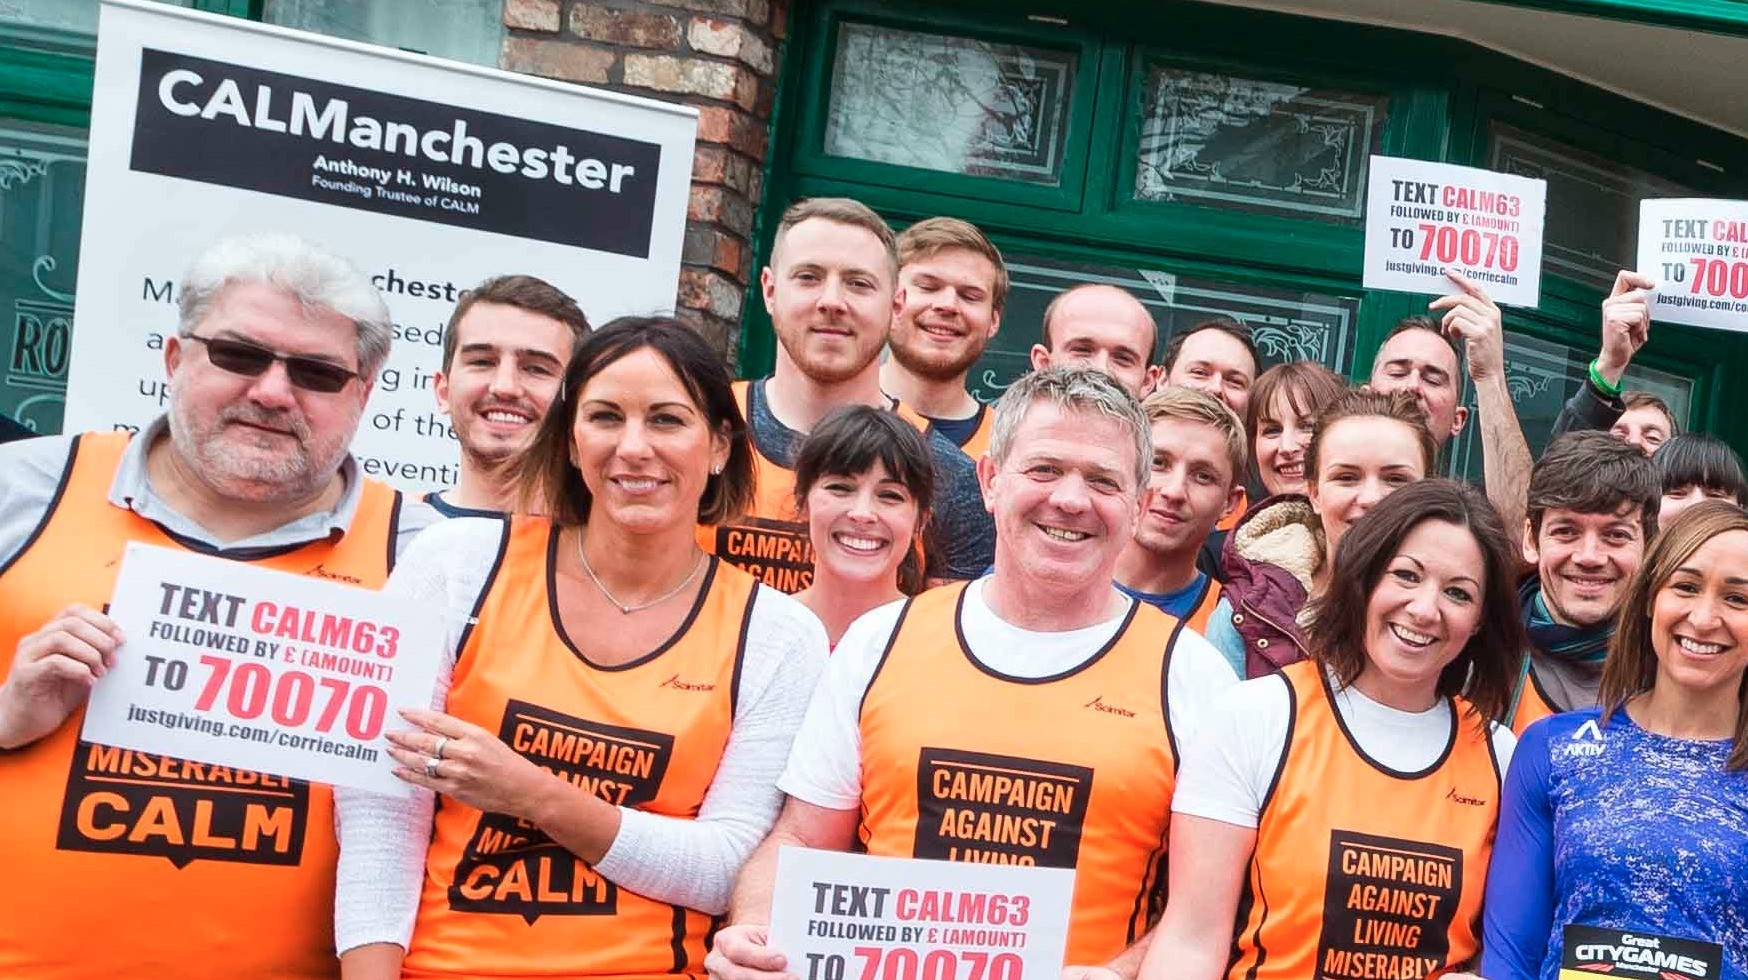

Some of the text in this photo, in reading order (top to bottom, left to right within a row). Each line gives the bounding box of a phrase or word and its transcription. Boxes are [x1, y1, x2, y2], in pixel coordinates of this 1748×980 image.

[158, 69, 635, 194] CALManchester
[312, 175, 480, 214] Founding Trustee of CALM
[313, 155, 482, 198] Anthony H. Wilson
[1390, 204, 1461, 224] FOLLOWED BY
[1391, 179, 1520, 217] TEXT CALM63
[1389, 223, 1519, 273] TO 70070
[1661, 241, 1715, 256] FOLLOWED
[1716, 244, 1731, 257] BY
[1662, 218, 1709, 240] TEXT
[1661, 262, 1686, 284] TO
[373, 411, 404, 431] of
[149, 620, 250, 655] FOLLOWED
[253, 640, 280, 660] BY
[159, 582, 400, 659] TEXT CALM63
[144, 654, 388, 742] TO 70070
[126, 703, 379, 763] justgiving.com/corriecalm
[513, 722, 655, 779] CAMPAIGN
[933, 768, 1074, 814] CAMPAIGN
[76, 792, 294, 853] CALM
[939, 808, 1056, 849] AGAINST
[459, 856, 607, 903] CALM
[1341, 848, 1454, 890] CAMPAIGN
[812, 881, 1031, 927] TEXT CALM63
[1346, 885, 1441, 921] AGAINST
[807, 919, 897, 942] FOLLOWED
[900, 926, 924, 944] BY
[1354, 921, 1422, 949] LIVING
[1621, 934, 1661, 949] Great
[1324, 947, 1439, 980] MISERABLY
[1575, 944, 1708, 978] CITYGAMES
